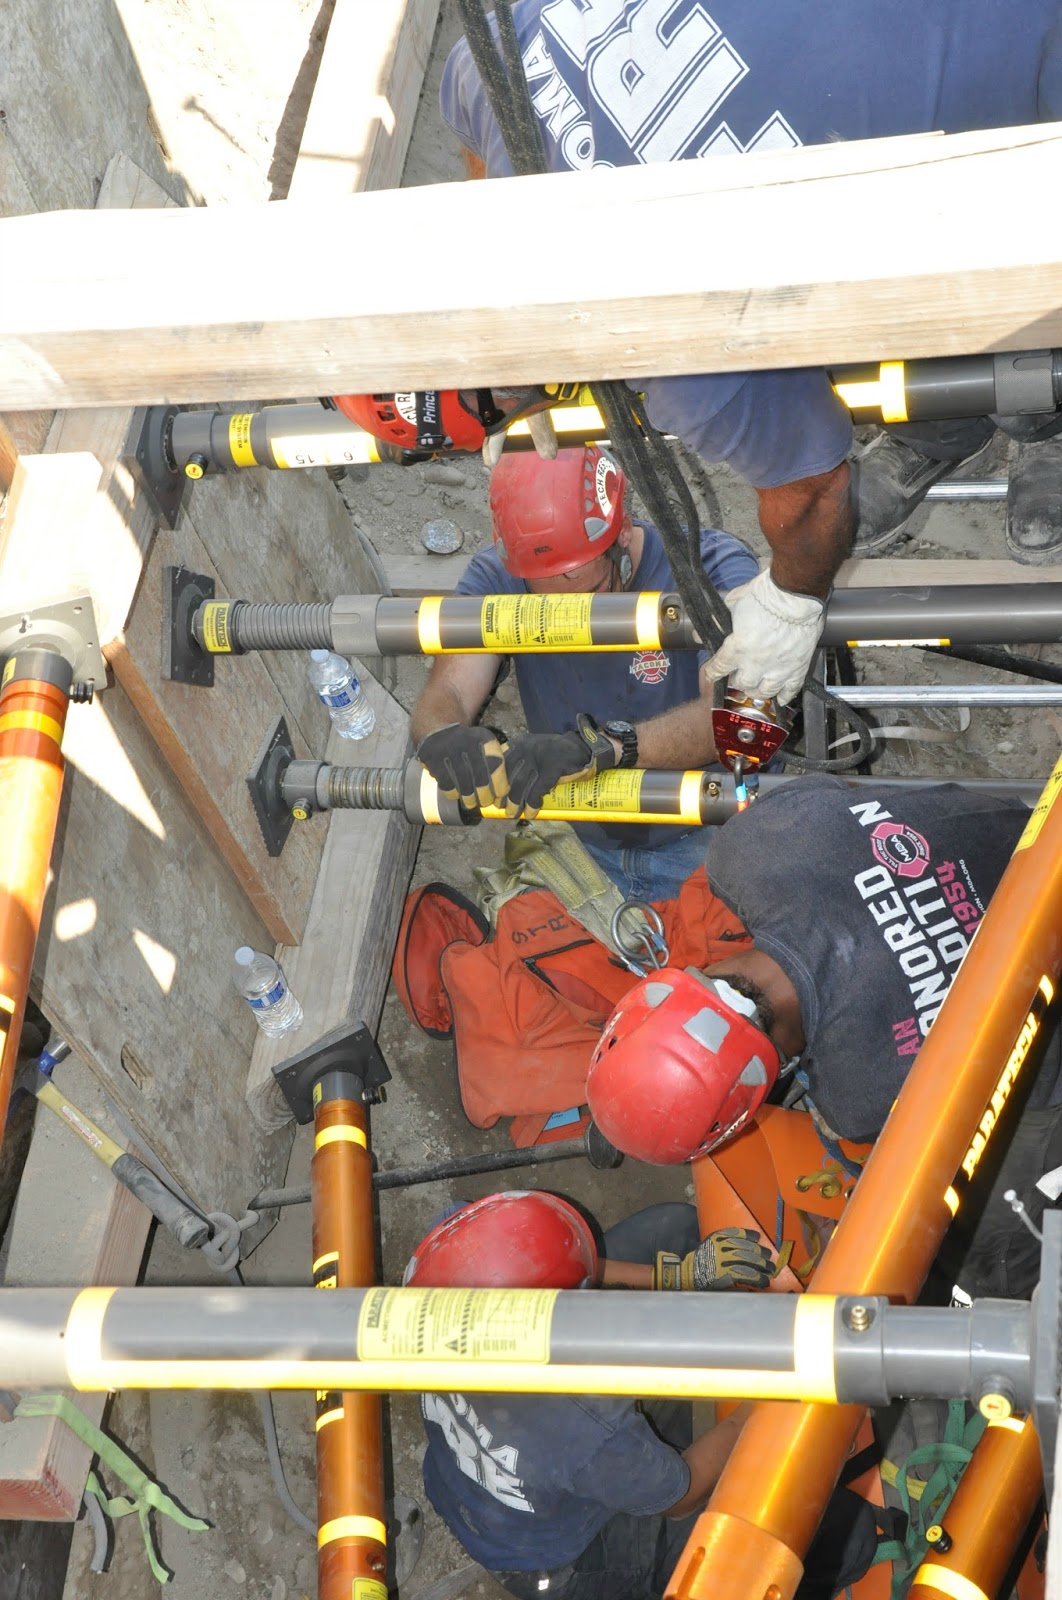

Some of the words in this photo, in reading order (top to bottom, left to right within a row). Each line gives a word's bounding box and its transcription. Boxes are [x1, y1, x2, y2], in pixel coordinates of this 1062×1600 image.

[522, 29, 617, 169] OMA
[597, 478, 608, 507] TECH
[217, 607, 228, 647] PARATECH
[633, 660, 667, 672] TACOMA
[891, 834, 912, 862] MDA
[959, 859, 976, 893] MDA.ORG
[935, 861, 981, 934] 1954
[892, 1017, 921, 1056] AN
[961, 1012, 1041, 1182] PARATECH
